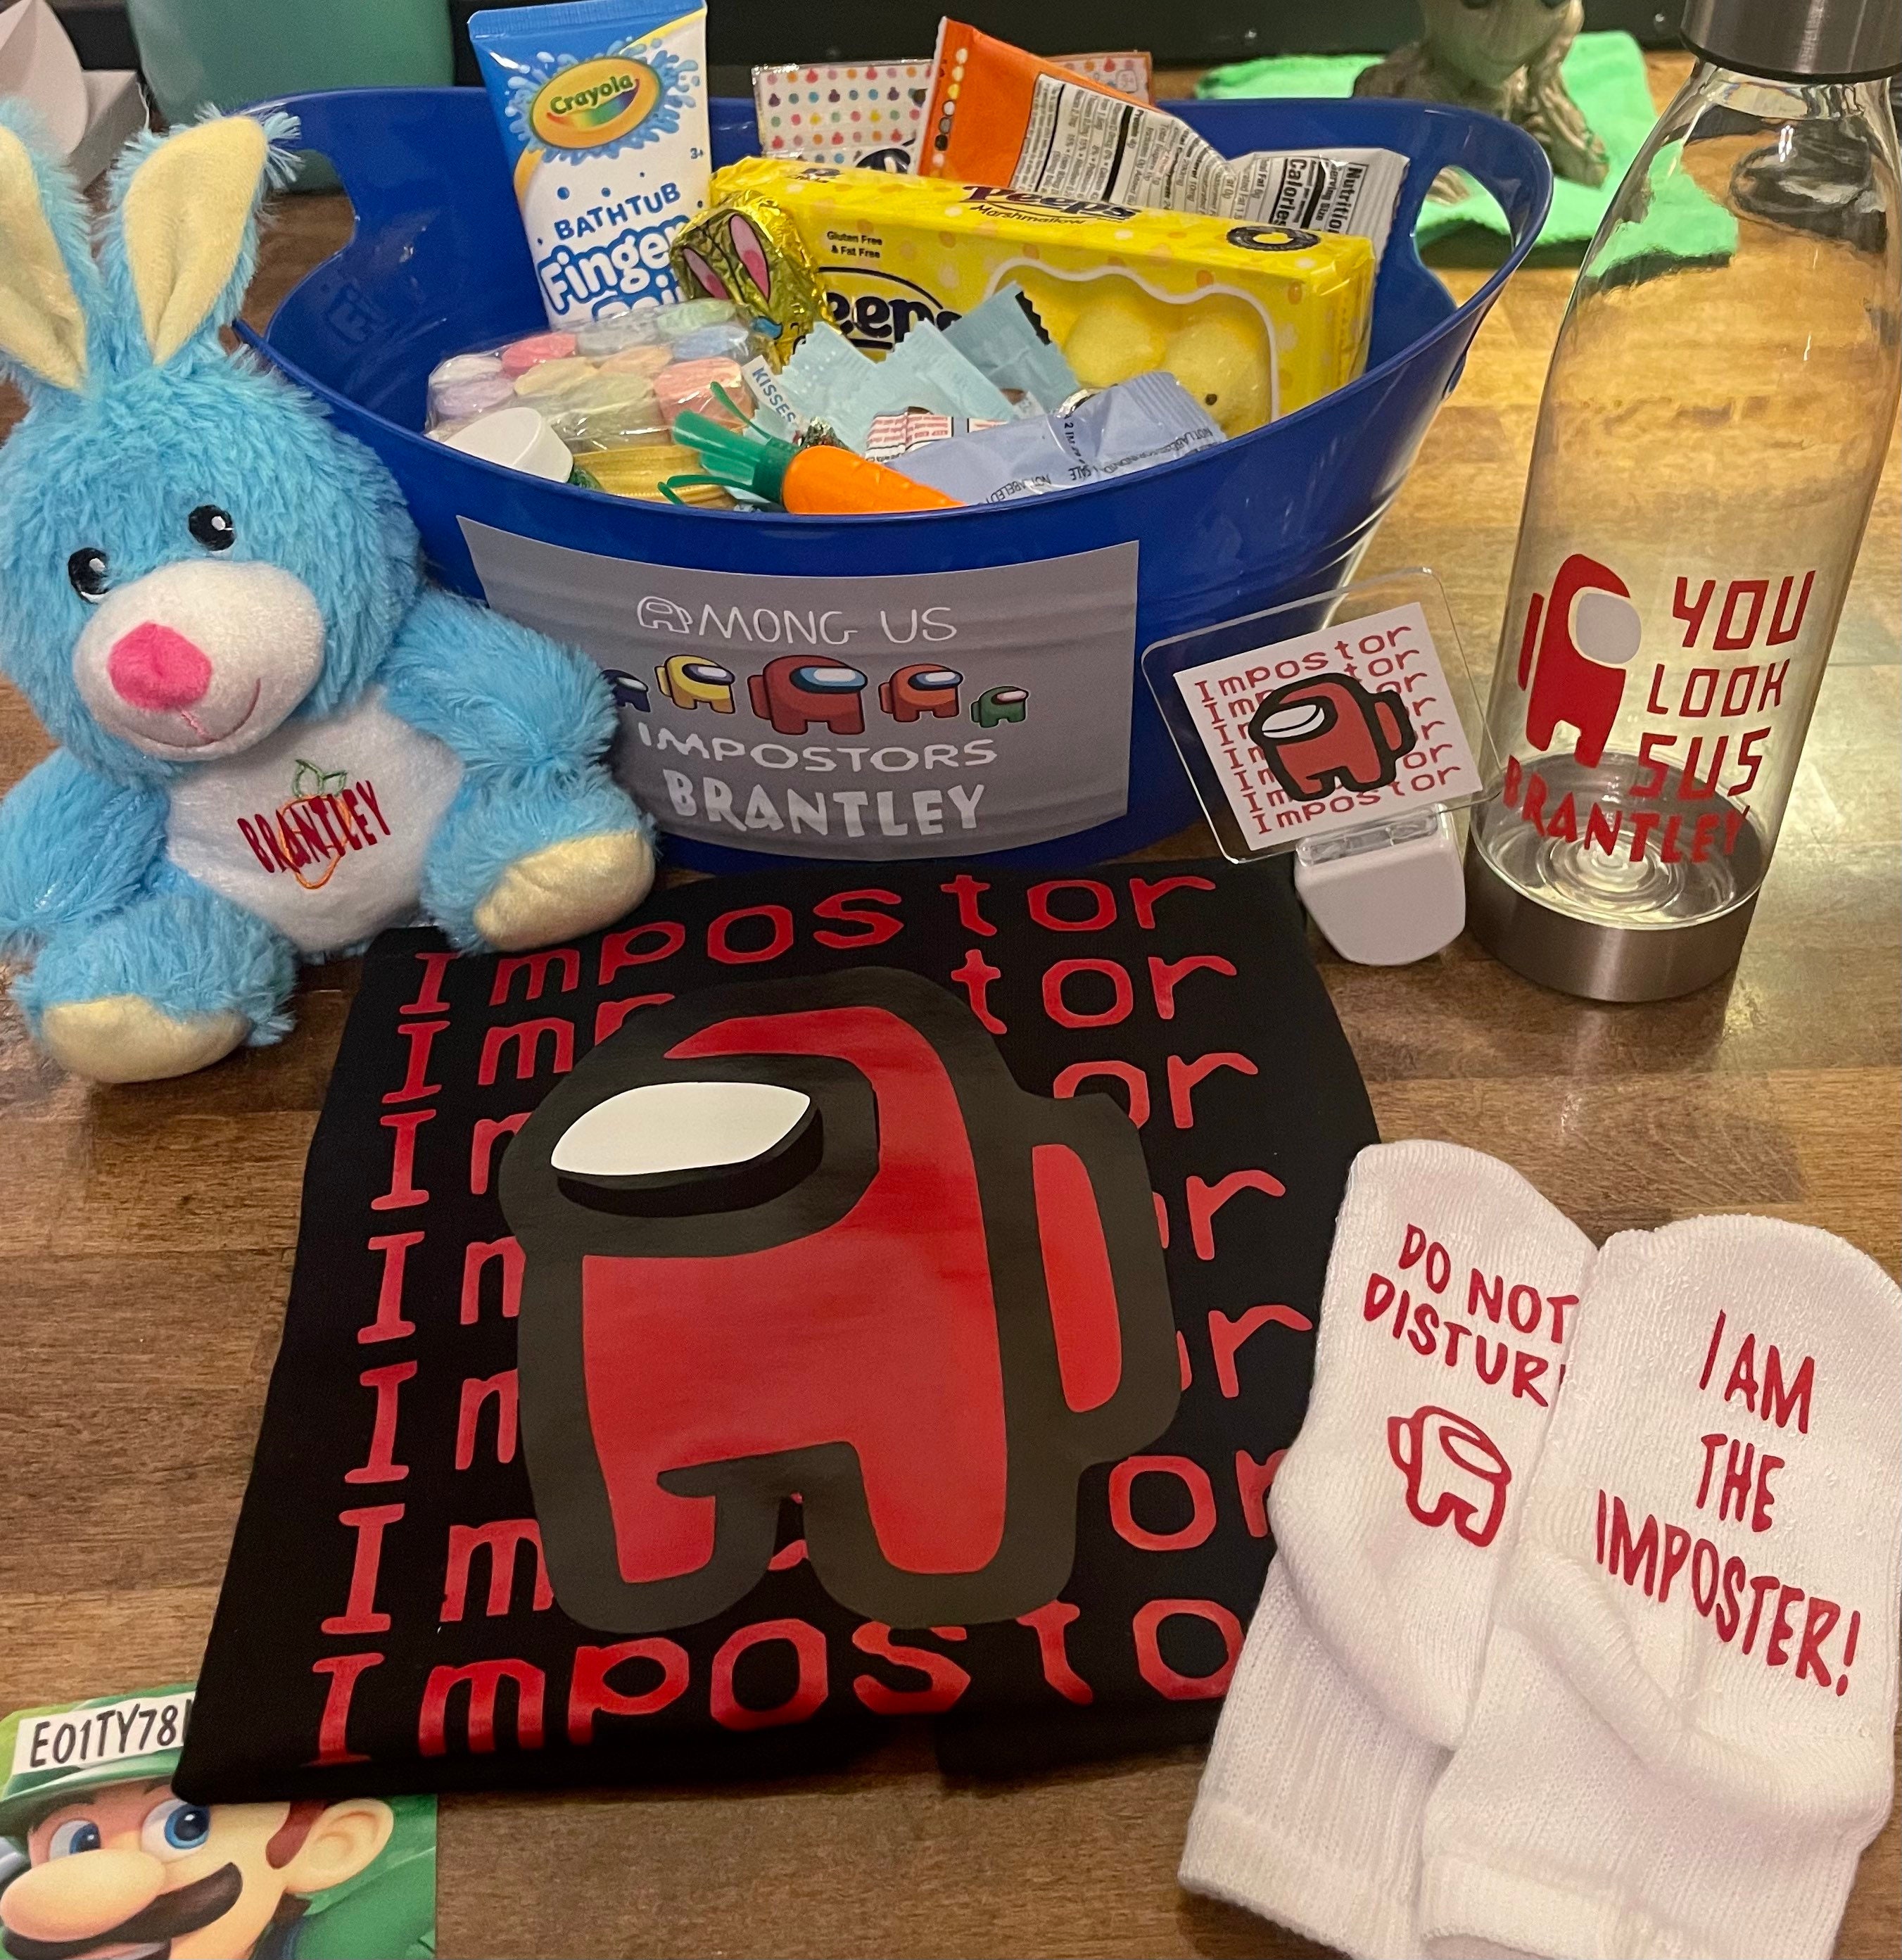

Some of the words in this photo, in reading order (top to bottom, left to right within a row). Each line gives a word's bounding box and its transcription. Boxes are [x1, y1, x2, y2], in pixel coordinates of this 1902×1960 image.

[550, 75, 633, 114] Crayola
[690, 148, 704, 159] 3+
[554, 182, 680, 240] BATHTUB
[962, 186, 1141, 219] Peeps
[970, 204, 1086, 225] Marshmallow
[1273, 159, 1307, 226] Calories
[827, 231, 858, 242] Gluten
[861, 235, 882, 245] Free
[841, 246, 856, 256] Fat
[859, 248, 880, 258] Free
[880, 607, 958, 643] US
[1672, 570, 1816, 650] YOU
[1194, 626, 1412, 703] Impostor
[1646, 659, 1790, 717] LOOK
[638, 722, 998, 773] IMPOSTORS
[1628, 726, 1772, 802] SUS
[237, 780, 391, 874] BRANTLEY
[662, 769, 984, 837] BRANTLEY
[399, 875, 1216, 1014] Impostor
[1397, 1223, 1451, 1294] DO
[1467, 1267, 1580, 1344] NOT
[1363, 1272, 1566, 1408] DISTUR
[1699, 1308, 1727, 1391] I
[1724, 1332, 1815, 1434] AM
[1696, 1433, 1785, 1533] THE
[1596, 1489, 1861, 1697] IMPOSTER!
[300, 1599, 1247, 1767] Imposto
